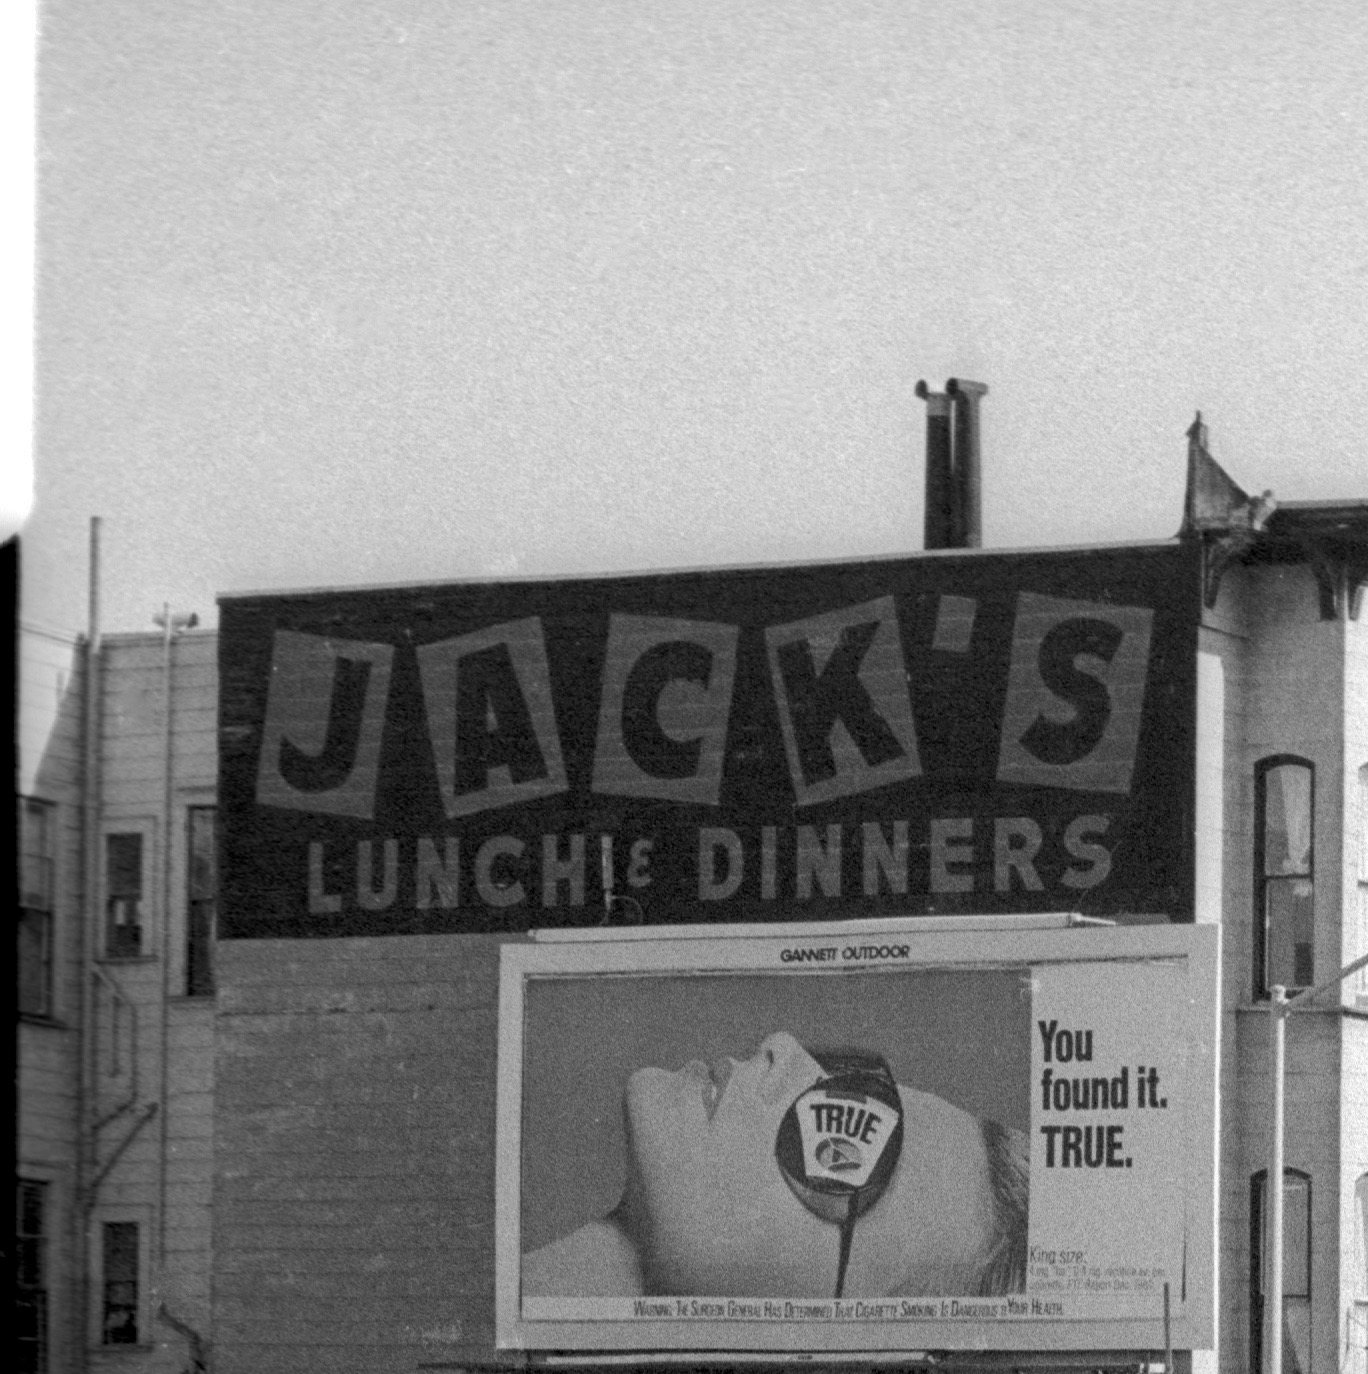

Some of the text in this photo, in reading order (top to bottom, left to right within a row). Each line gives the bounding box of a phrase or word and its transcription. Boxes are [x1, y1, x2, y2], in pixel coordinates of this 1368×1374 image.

[276, 596, 1130, 800] JACK'S
[308, 834, 585, 913] LUNCH
[699, 814, 1113, 902] DINNERS
[781, 945, 910, 962] GANNETT OUTDOOR
[1038, 1019, 1093, 1063] You
[1041, 1065, 1168, 1112] found it.
[809, 1102, 882, 1145] TRUE
[1040, 1125, 1133, 1168] TRUE.
